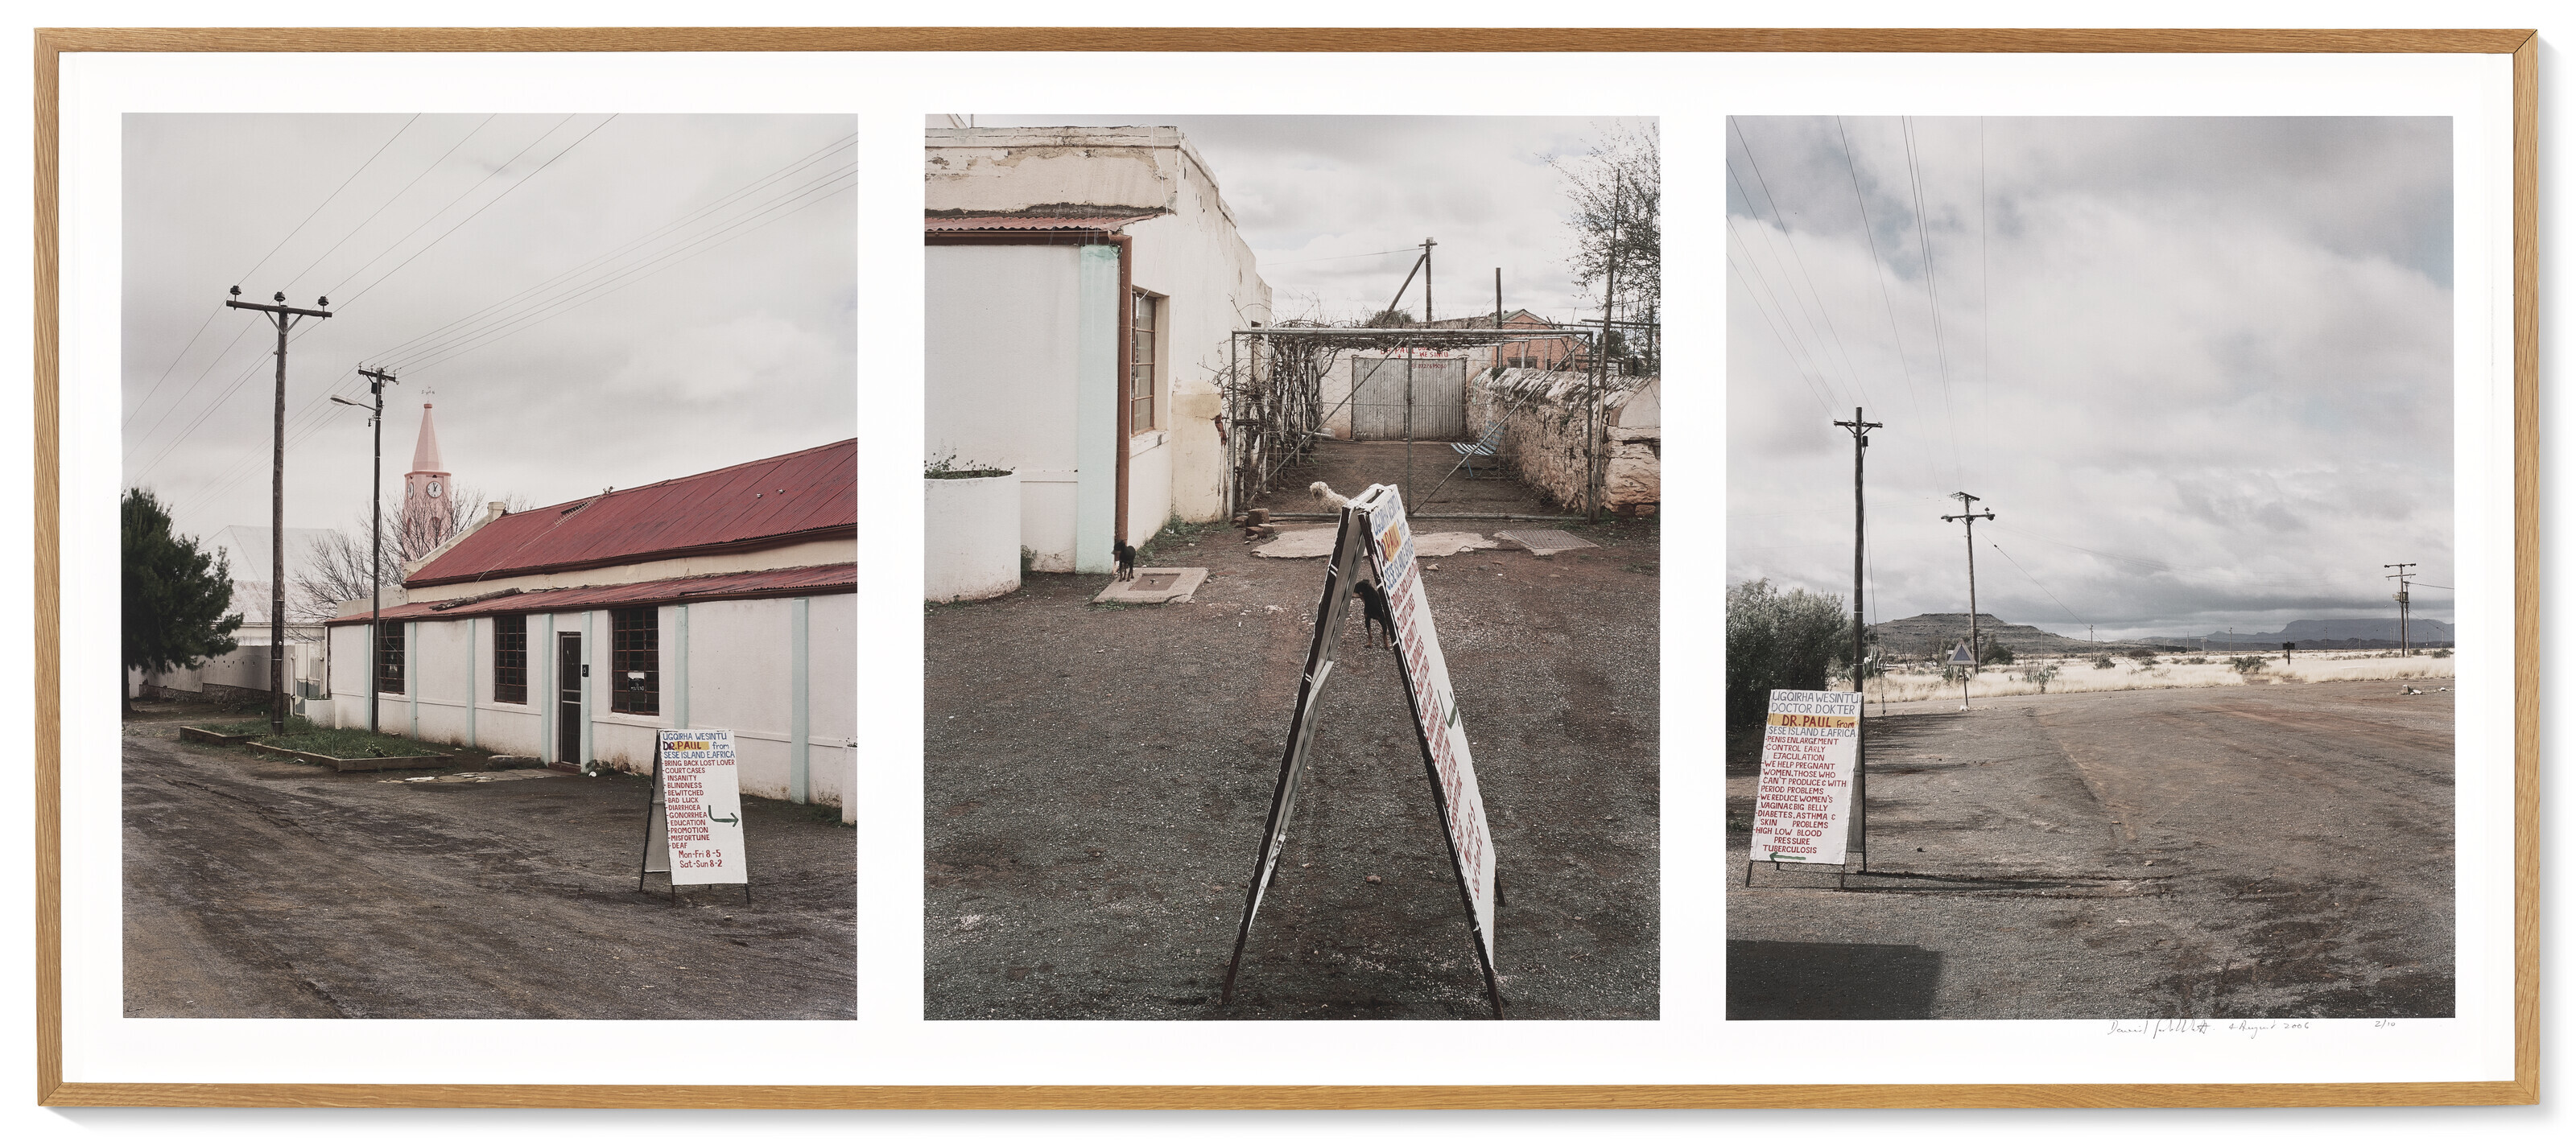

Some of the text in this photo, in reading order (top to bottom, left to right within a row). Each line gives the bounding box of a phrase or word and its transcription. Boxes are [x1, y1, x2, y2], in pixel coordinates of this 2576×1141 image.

[1773, 691, 1859, 703] UGQIRHA WESINTU
[1771, 702, 1855, 715] DOCTOR DOKTER
[1837, 720, 1854, 728] from
[1769, 727, 1785, 735] SESE
[1789, 727, 1818, 736] ISLAND
[663, 732, 692, 740] UGQIRHA
[712, 741, 729, 749] from
[1787, 737, 1839, 745] ENLARGEMENT
[1773, 752, 1824, 761] EJACULATION
[1789, 778, 1820, 786] PRODUCE
[1774, 837, 1810, 845] PRESSURE
[1763, 845, 1817, 853] TUBERCULOSIS
[2284, 1022, 2310, 1030] 2006
[2375, 1019, 2396, 1029] 2/10
